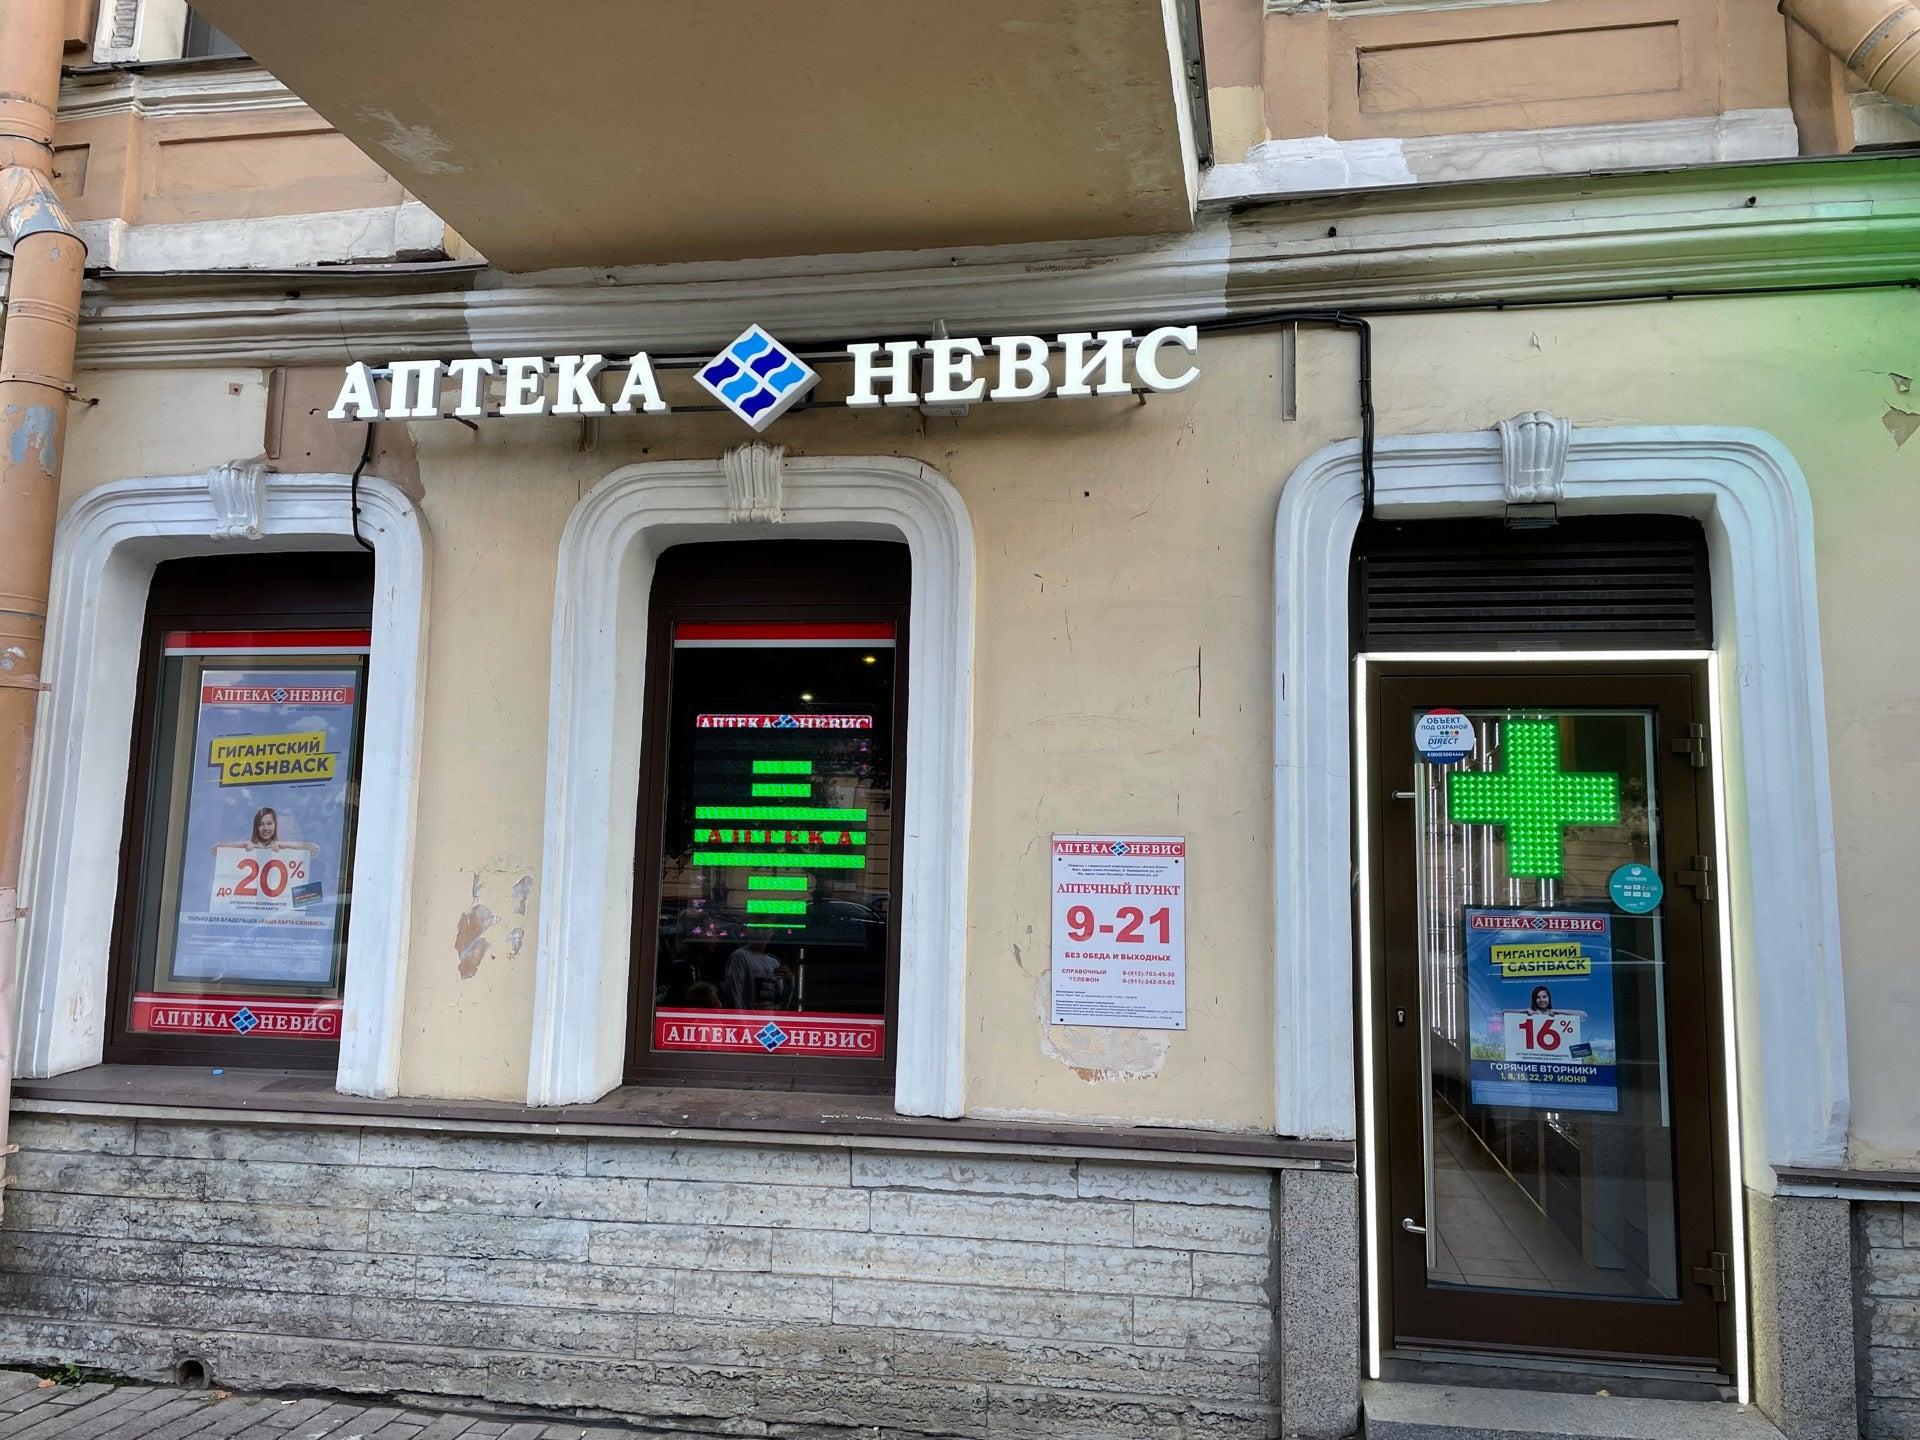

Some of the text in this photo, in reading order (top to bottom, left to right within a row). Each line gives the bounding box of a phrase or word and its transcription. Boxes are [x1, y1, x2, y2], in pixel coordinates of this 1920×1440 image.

[327, 325, 1201, 422] АПТЕКА НЕВИС
[214, 689, 343, 702] АПТЕКА НЕВИС
[701, 717, 869, 728] АПТЕКА НЕВИС
[217, 737, 320, 758] ГИГАНТСКИЙ
[229, 757, 329, 777] CASHBACK
[1056, 843, 1181, 854] АПТЕКА НЕВИС
[234, 858, 305, 898] 20%
[1057, 882, 1180, 895] АПТЕЧНЫЙ ПУНКТ
[1066, 905, 1170, 943] 9-21
[1474, 917, 1603, 930] АПТЕКА НЕВИС
[1082, 952, 1110, 960] ОБЕДА
[1121, 953, 1171, 962] ВЫХОДНЫХ
[1496, 946, 1577, 959] ГИГАНТСКИЙ
[1507, 959, 1586, 972] CASHBACK
[154, 1011, 332, 1032] АПТЕКА НЕВИС
[667, 1026, 872, 1048] АПТЕКА НЕВИС
[1519, 1018, 1573, 1051] 16%
[1490, 1062, 1597, 1075] ГОРЯЧИЕ ВТОРНИКИ
[1557, 1075, 1586, 1083] ИЮНЯ
